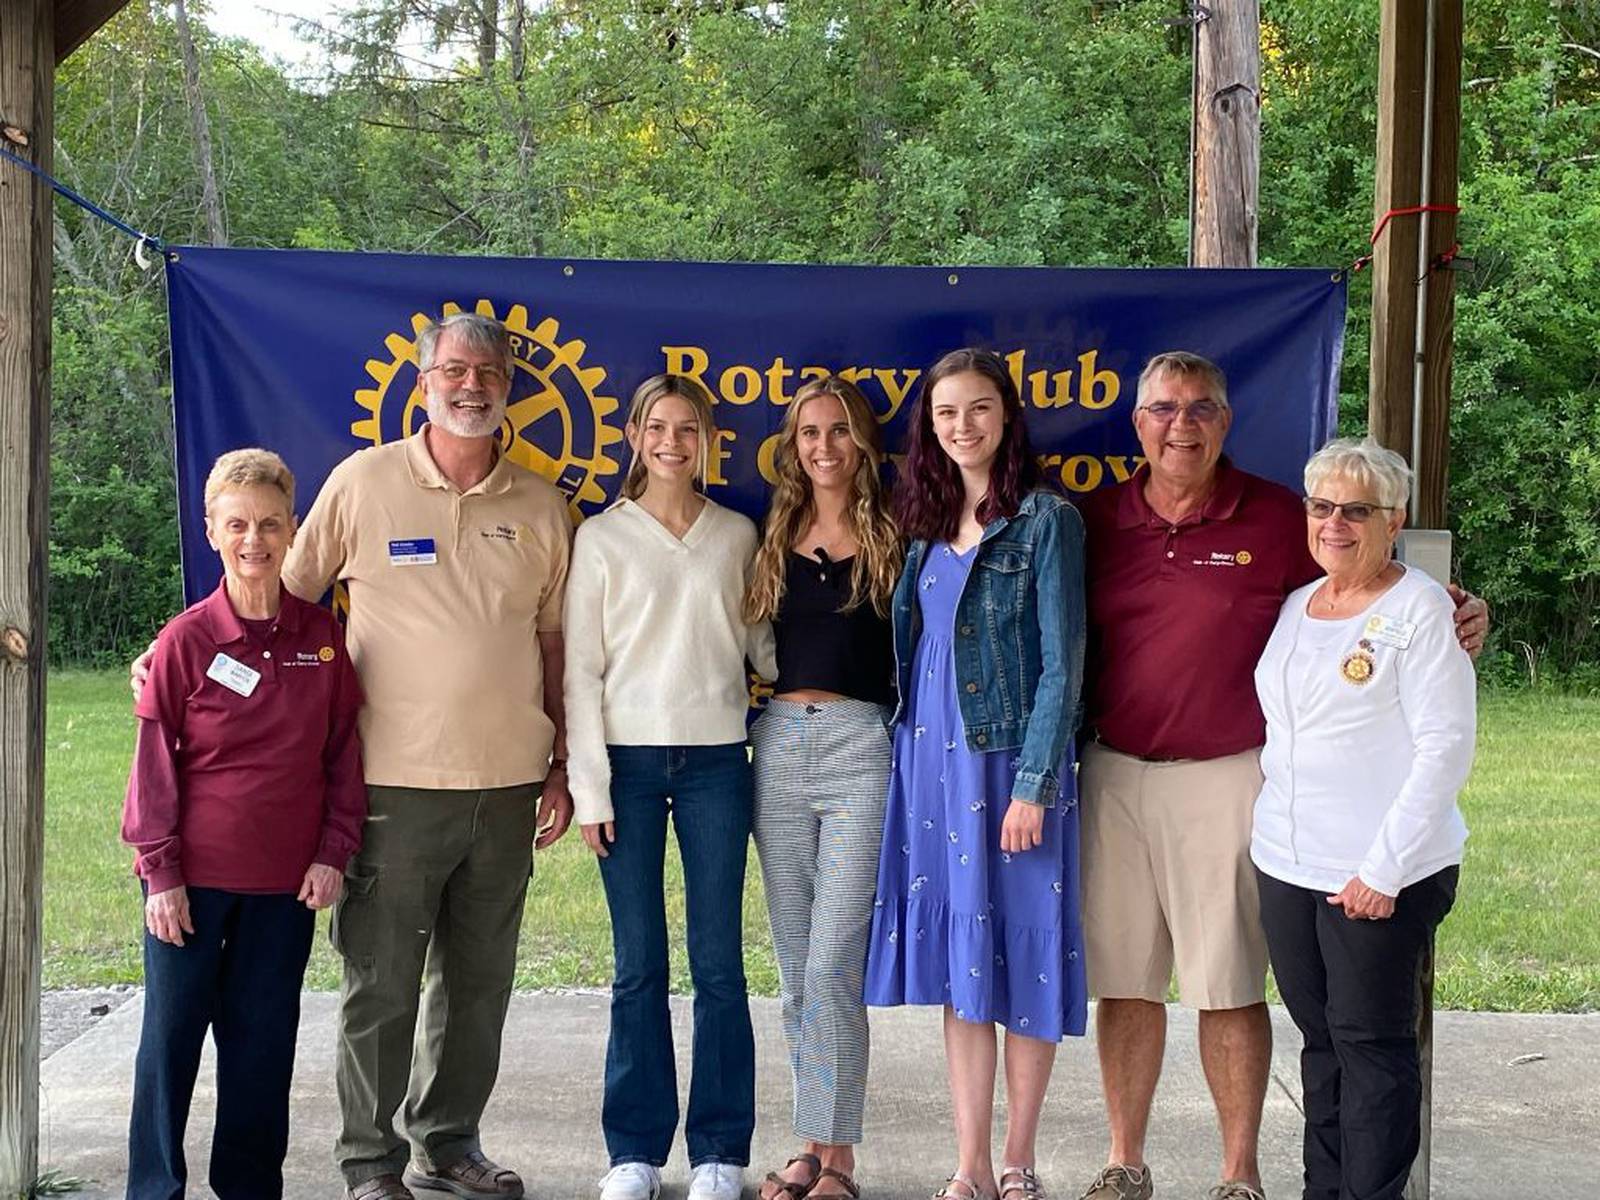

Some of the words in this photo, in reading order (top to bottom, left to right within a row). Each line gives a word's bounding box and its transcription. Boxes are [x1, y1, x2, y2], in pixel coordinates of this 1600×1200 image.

[661, 346, 921, 424] Roty
[1004, 349, 1121, 410] lub
[707, 429, 737, 486] f
